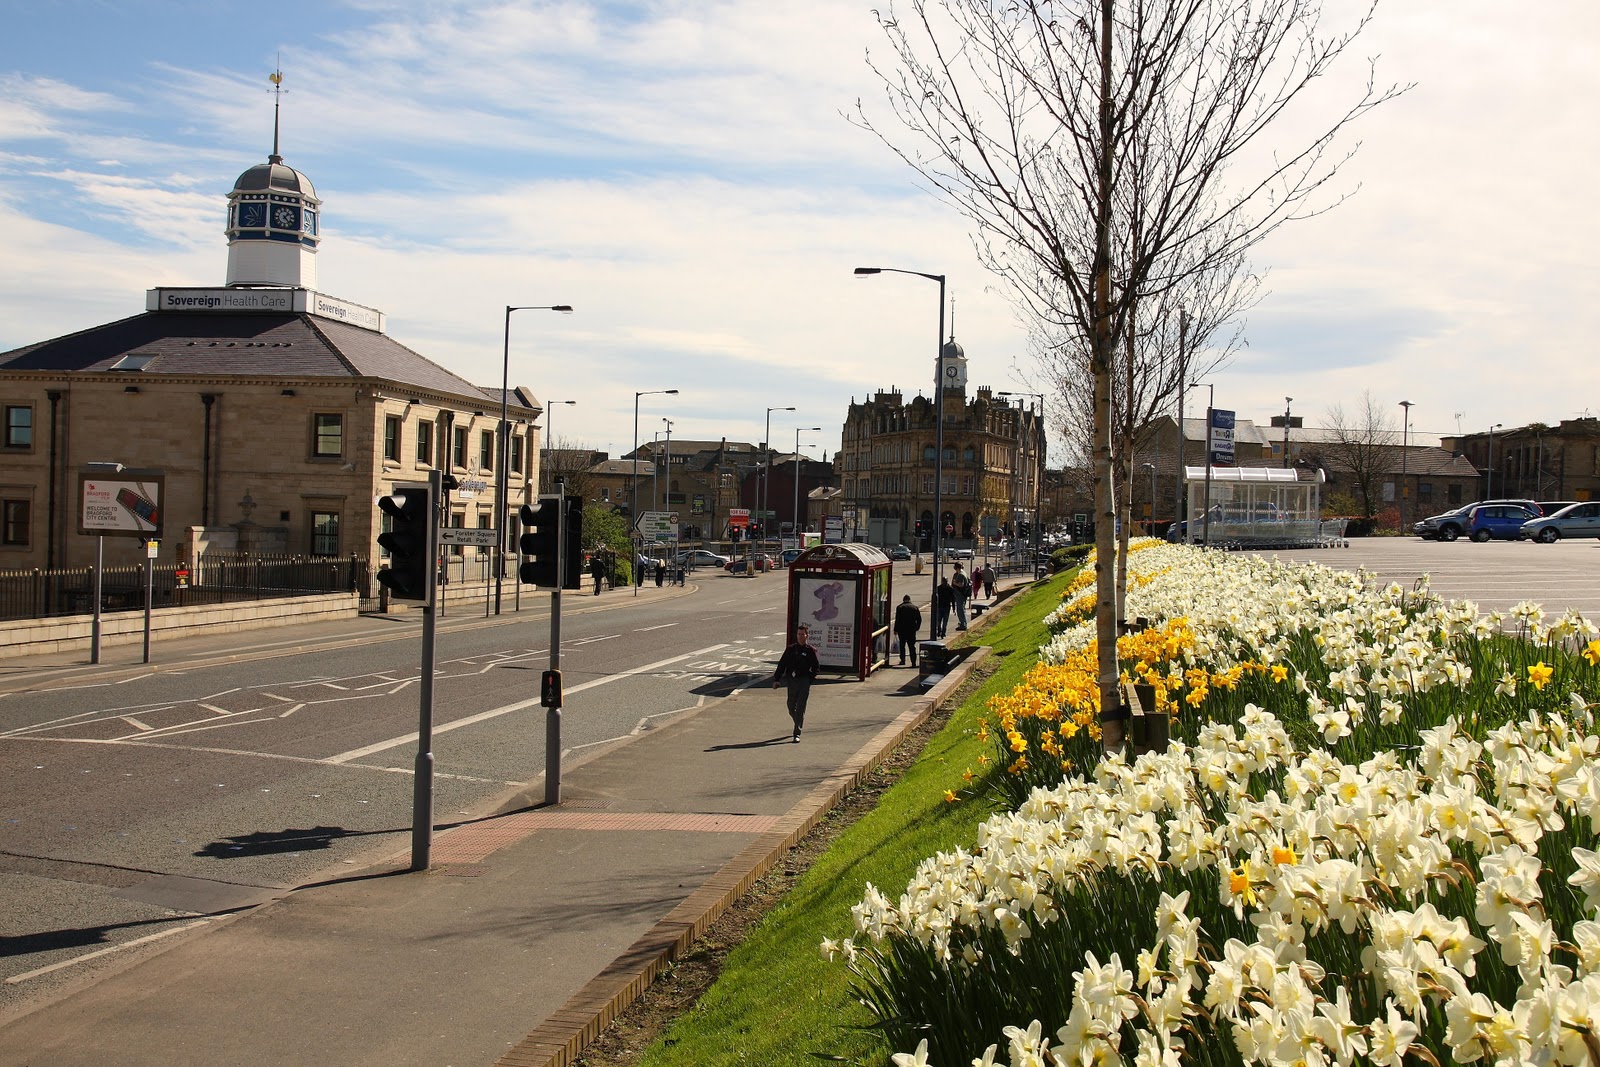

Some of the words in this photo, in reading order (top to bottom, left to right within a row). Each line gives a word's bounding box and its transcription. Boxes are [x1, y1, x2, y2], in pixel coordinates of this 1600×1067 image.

[167, 295, 221, 307] Sovereign
[224, 295, 258, 307] Health
[261, 295, 286, 307] Care
[318, 300, 347, 318] Sovereign
[347, 307, 364, 321] Health
[365, 312, 377, 326] Care
